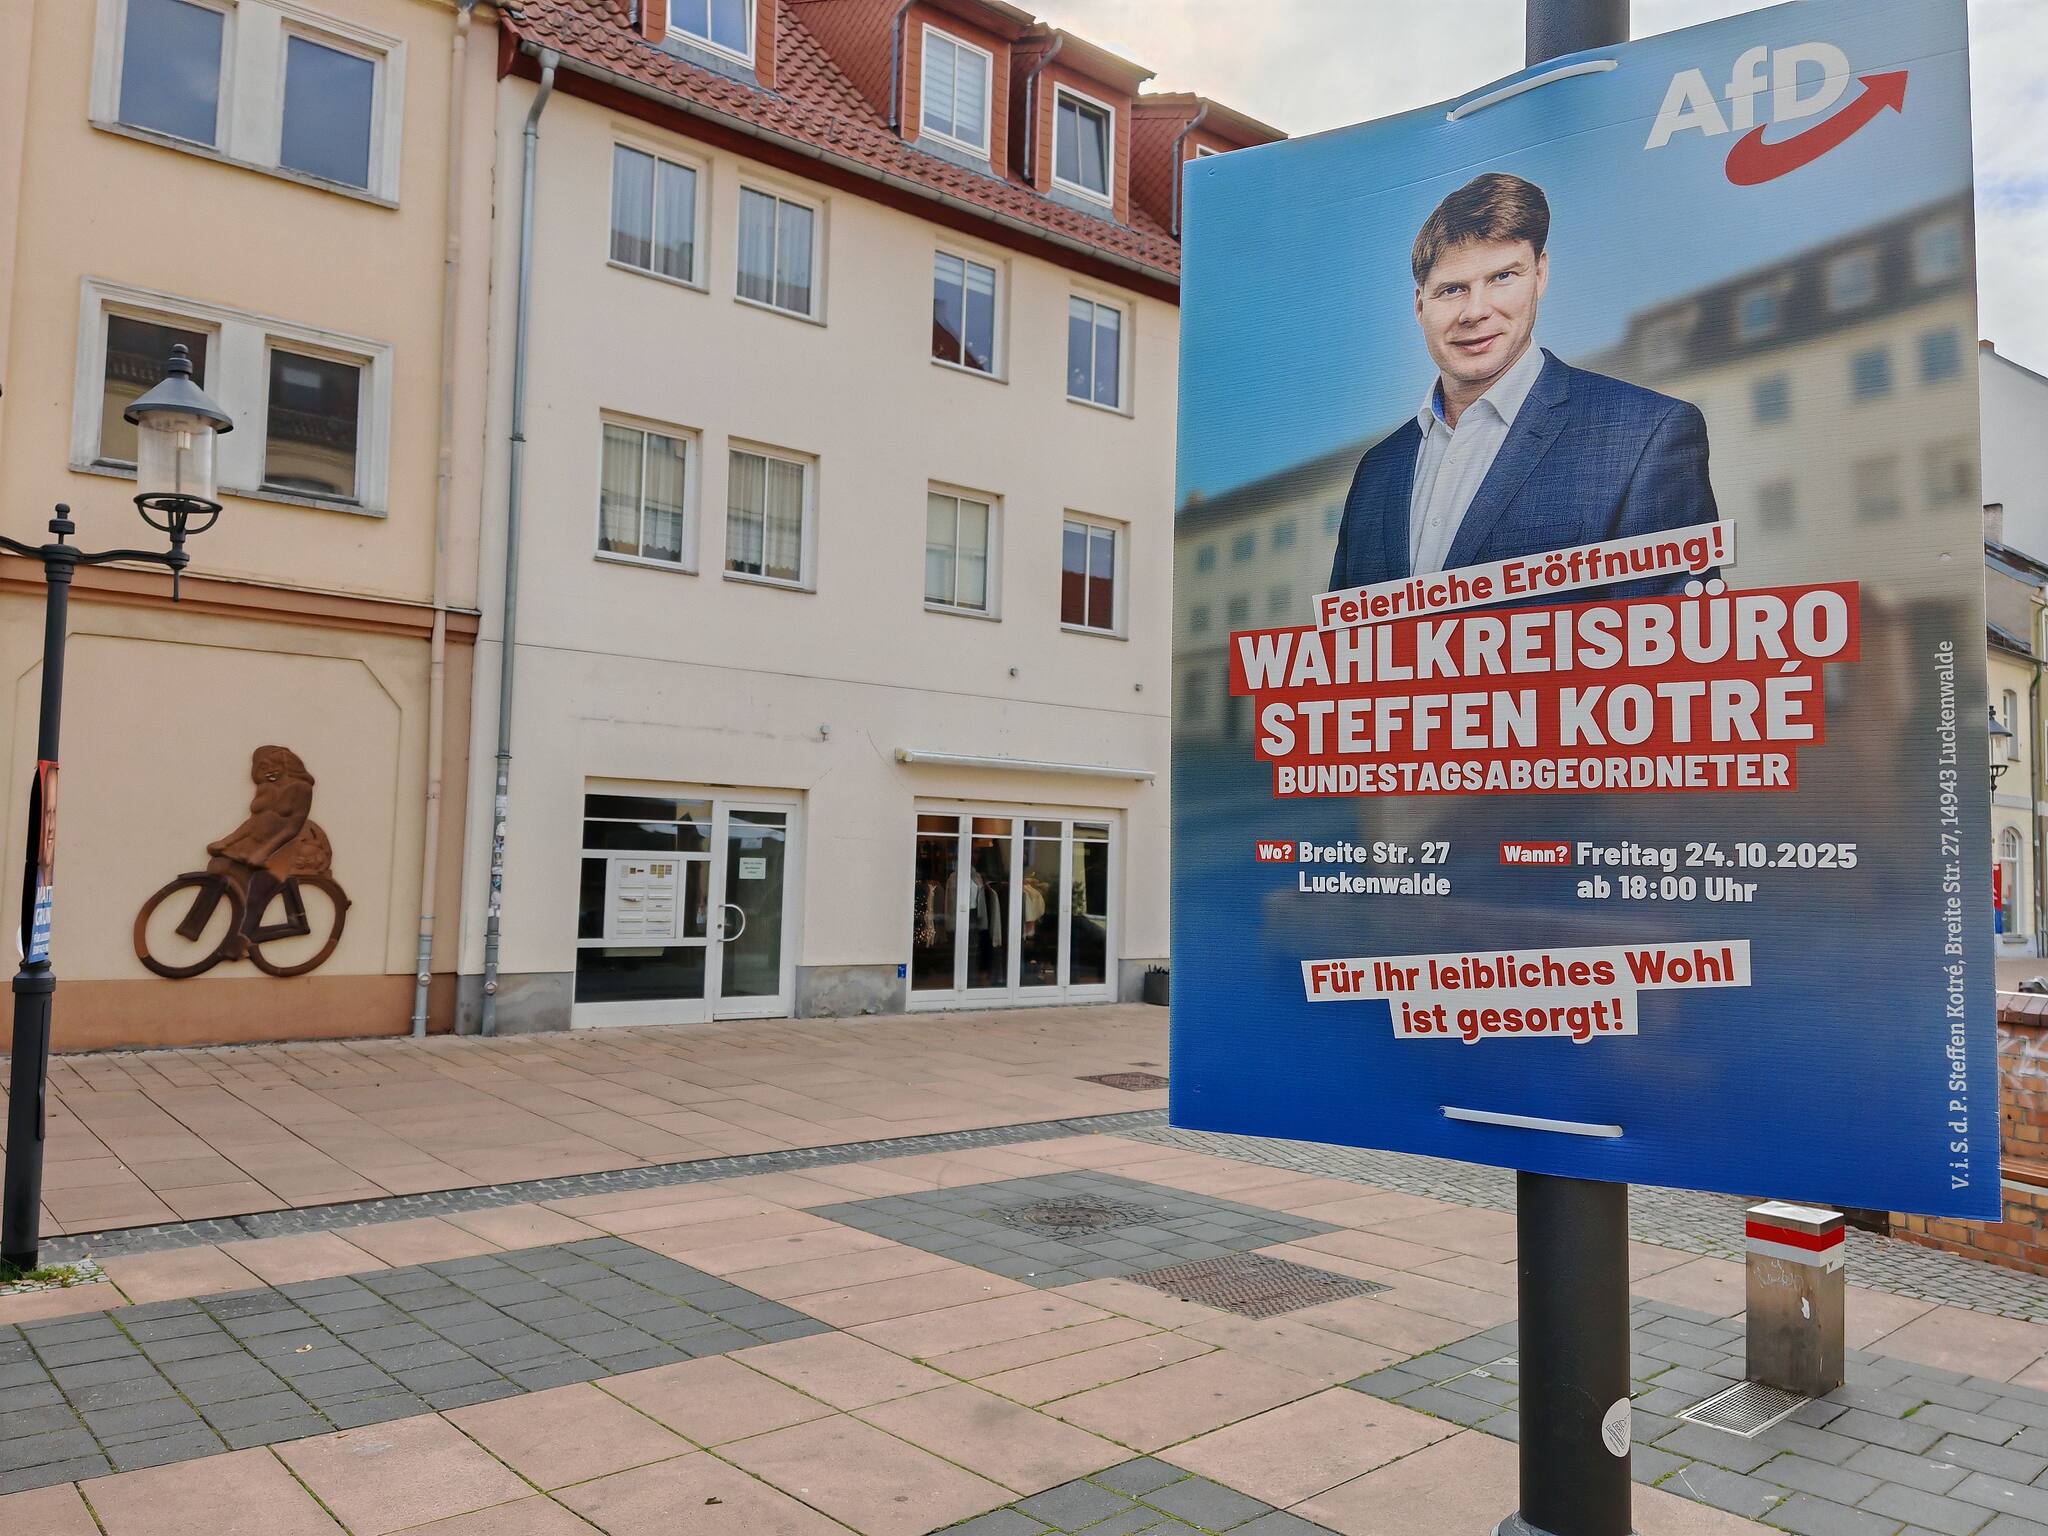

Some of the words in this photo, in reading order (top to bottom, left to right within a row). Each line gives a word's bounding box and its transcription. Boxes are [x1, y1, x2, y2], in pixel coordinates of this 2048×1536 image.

[1645, 42, 1850, 150] AfD
[1321, 574, 1493, 627] Feierliche
[1503, 526, 1726, 596] Eröffnung!
[1237, 580, 1849, 690] WAHLKREISBÜRO
[1260, 690, 1538, 757] STEFFEN
[1559, 661, 1815, 747] KOTRÉ
[1934, 640, 1957, 765] Luckenwalde
[1277, 754, 1790, 795] BUNDESTAGSABGEORDNETER
[1940, 770, 1959, 826] 14943
[1258, 843, 1293, 861] Wo?
[1299, 841, 1368, 864] Breite
[1373, 841, 1415, 864] Str.
[1421, 842, 1451, 864] 27
[1504, 845, 1568, 863] Wann?
[1577, 841, 1678, 871] Freitag
[1685, 842, 1858, 869] 24.10.2025
[1941, 829, 1962, 856] 27,
[1299, 871, 1451, 896] Luckenwalde
[1577, 875, 1611, 900] ab
[1619, 876, 1697, 901] 18:00
[1705, 876, 1758, 902] Uhr
[1943, 859, 1961, 893] Str.
[1943, 896, 1963, 956] Breite
[1310, 962, 1365, 993] Für
[1374, 961, 1420, 992] Ihr
[1429, 955, 1616, 991] leibliches
[1625, 948, 1735, 985] Wohl
[1942, 959, 1967, 1018] Kotré,
[1402, 1001, 1448, 1033] ist
[1456, 998, 1624, 1041] gesorgt!
[1946, 1023, 1967, 1092] Steffen
[1949, 1096, 1968, 1113] P.
[1948, 1116, 1968, 1134] d.
[1950, 1136, 1968, 1154] S.
[1950, 1157, 1969, 1169] i.
[1951, 1173, 1969, 1190] V.
